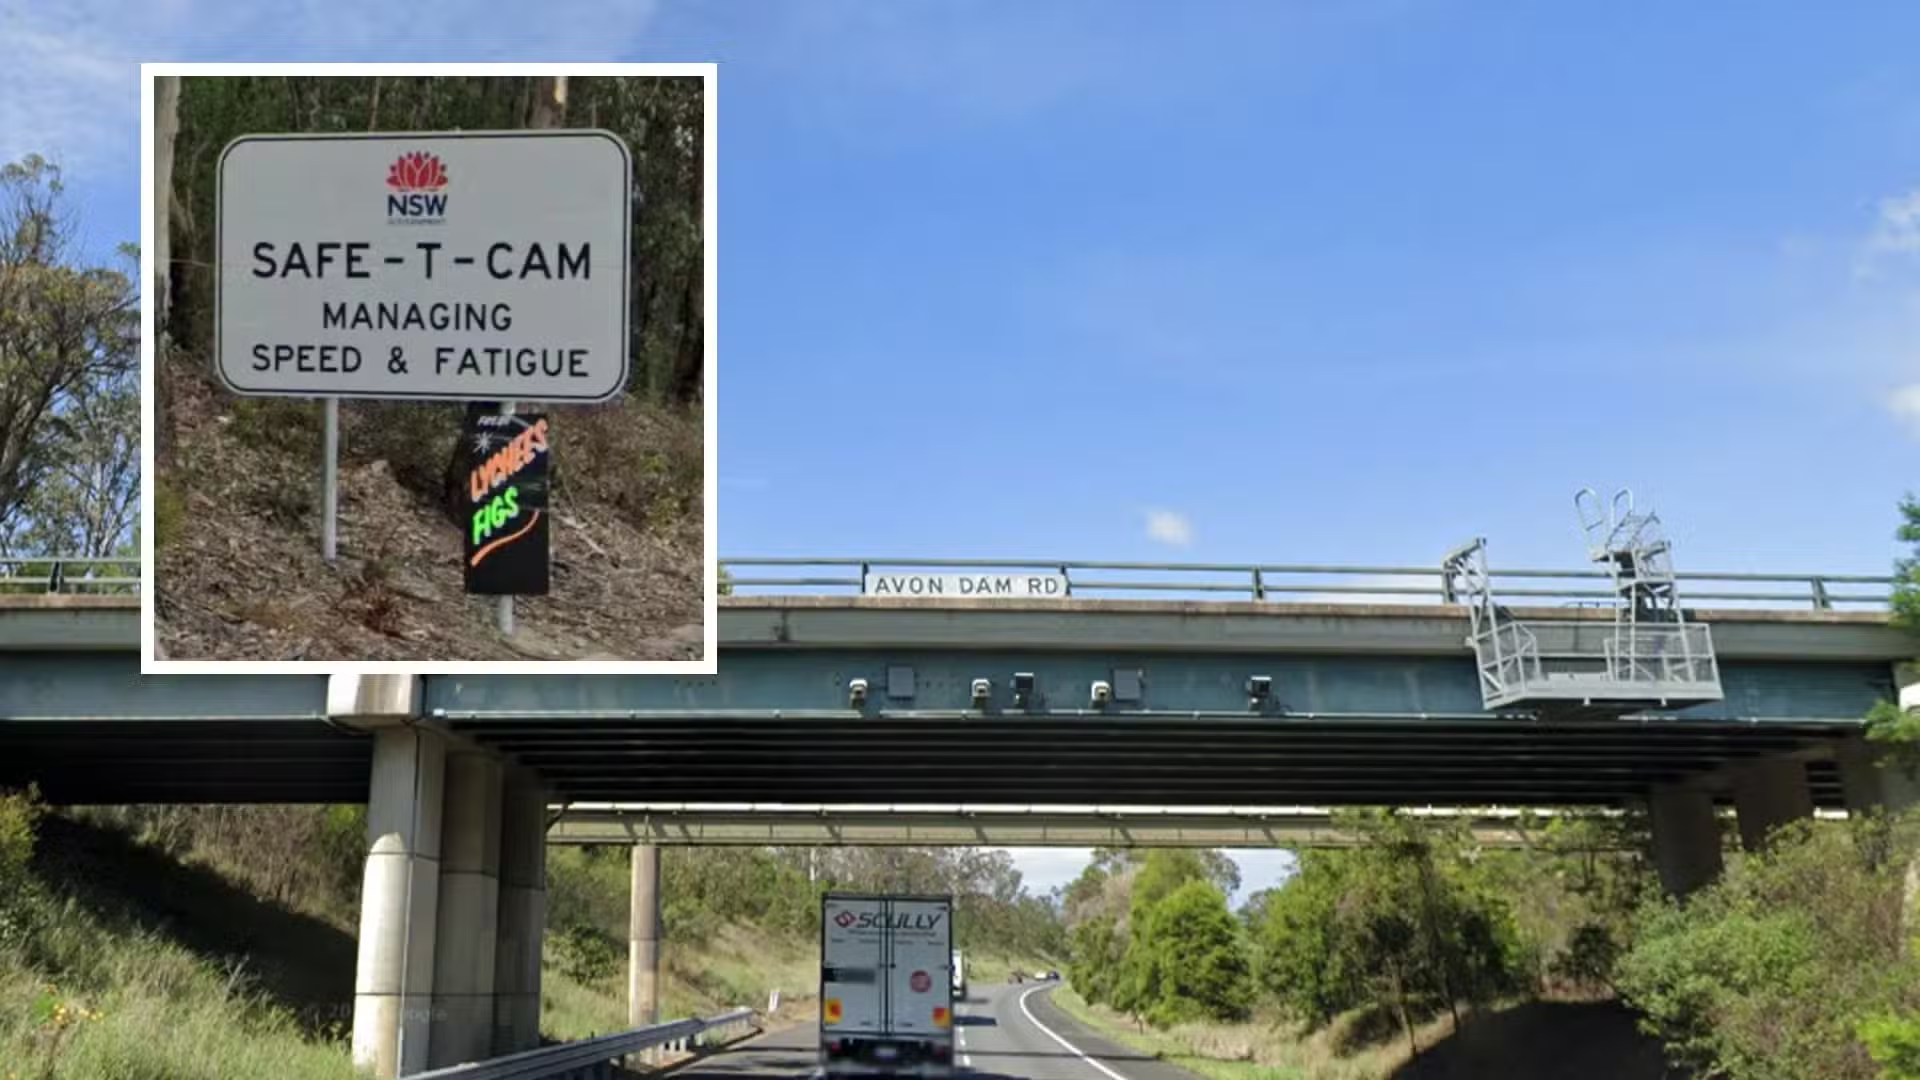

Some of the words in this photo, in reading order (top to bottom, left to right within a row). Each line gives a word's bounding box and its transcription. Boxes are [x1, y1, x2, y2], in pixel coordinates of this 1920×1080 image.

[387, 194, 448, 216] NSW
[322, 303, 512, 331] MANAGING
[252, 345, 363, 373] SPEED
[387, 347, 409, 375] &
[434, 348, 590, 377] FATIGUE
[473, 486, 519, 545] FIGS
[875, 576, 944, 594] AVON
[959, 576, 1012, 594] DAM
[1028, 577, 1059, 594] RD
